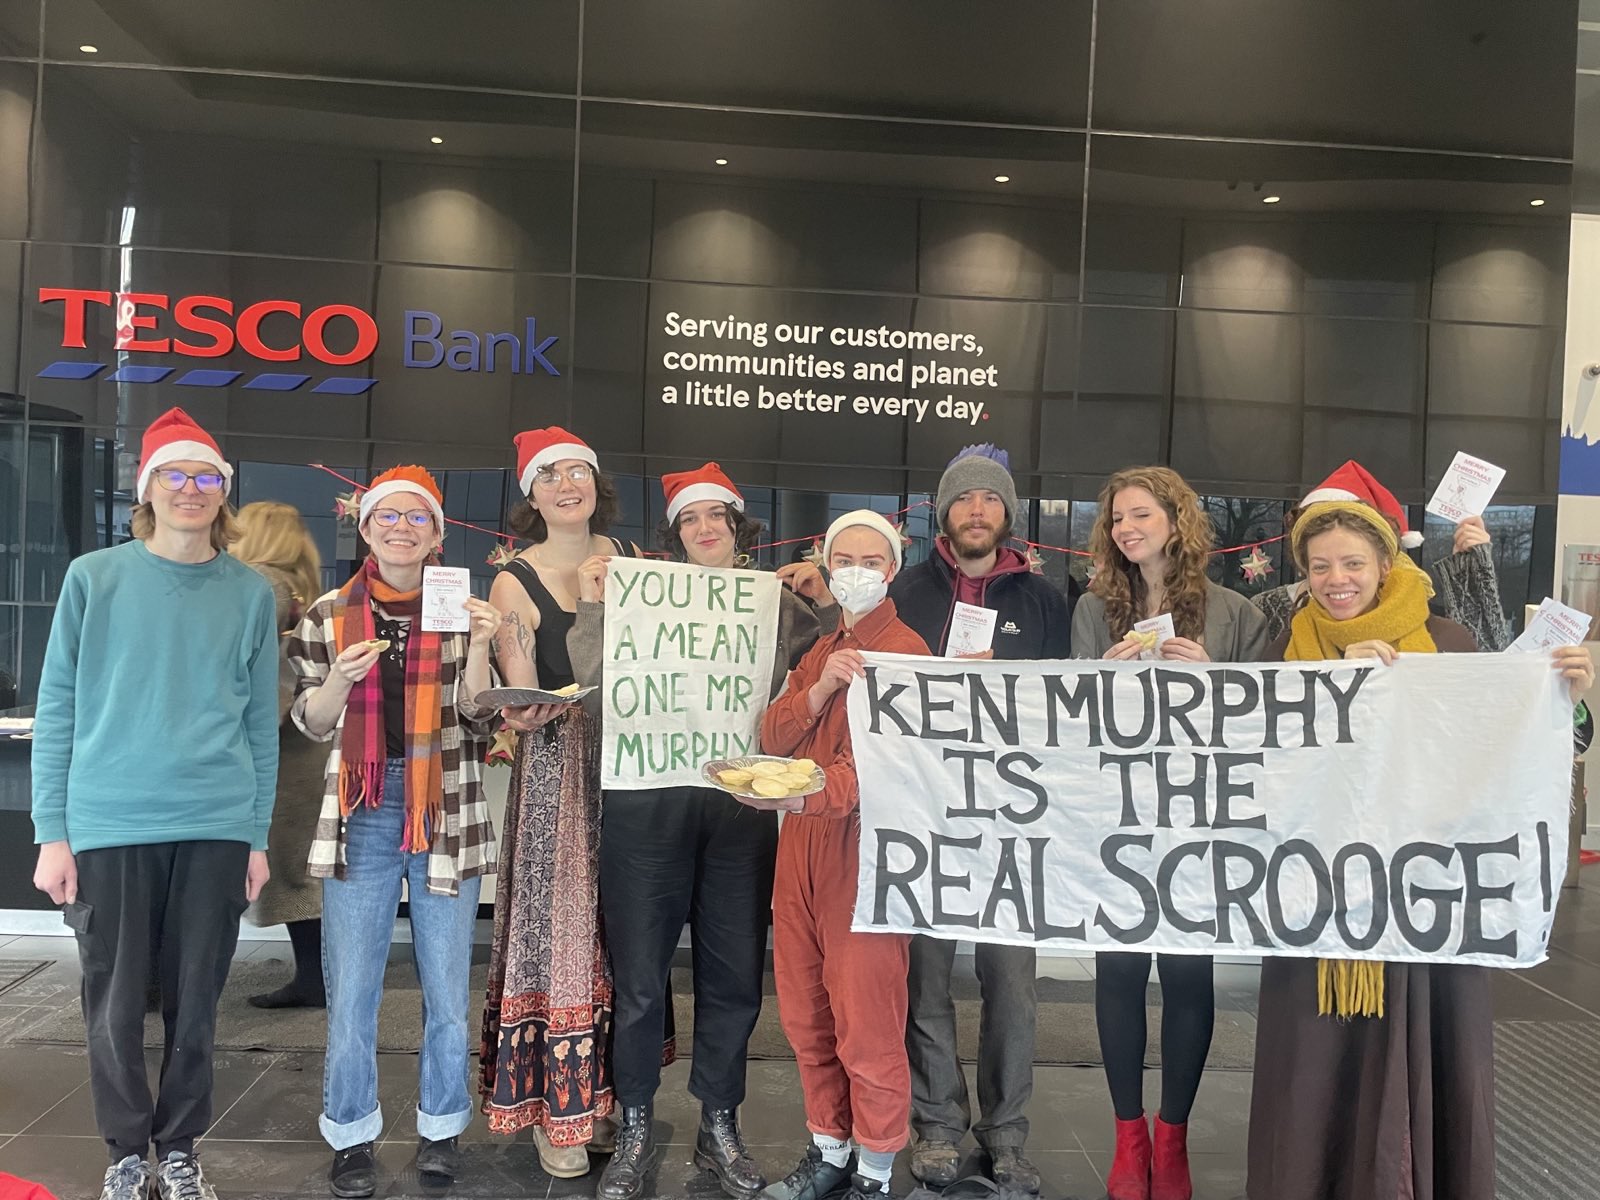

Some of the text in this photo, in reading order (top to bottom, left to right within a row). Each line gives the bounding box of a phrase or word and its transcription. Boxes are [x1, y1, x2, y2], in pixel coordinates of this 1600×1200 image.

[38, 288, 560, 375] TESCO Bank
[664, 312, 984, 357] Serving our customers,
[663, 351, 998, 389] communities and planet
[661, 382, 989, 426] a little better every day.
[1452, 463, 1492, 482] CHRISTMAS
[1463, 458, 1490, 473] MERRY
[1440, 503, 1462, 517] TESCO
[613, 570, 756, 614] YOU'RE
[955, 612, 988, 624] CHRISTMAS
[1558, 610, 1583, 631] MERRY
[613, 621, 758, 664] A MEAN
[611, 672, 753, 719] ONE MR
[863, 666, 1375, 749] KEN MURPHY
[614, 731, 753, 778] MURPHY
[943, 748, 1267, 831] IS THE
[871, 821, 1553, 958] REAL SCROOGE!
